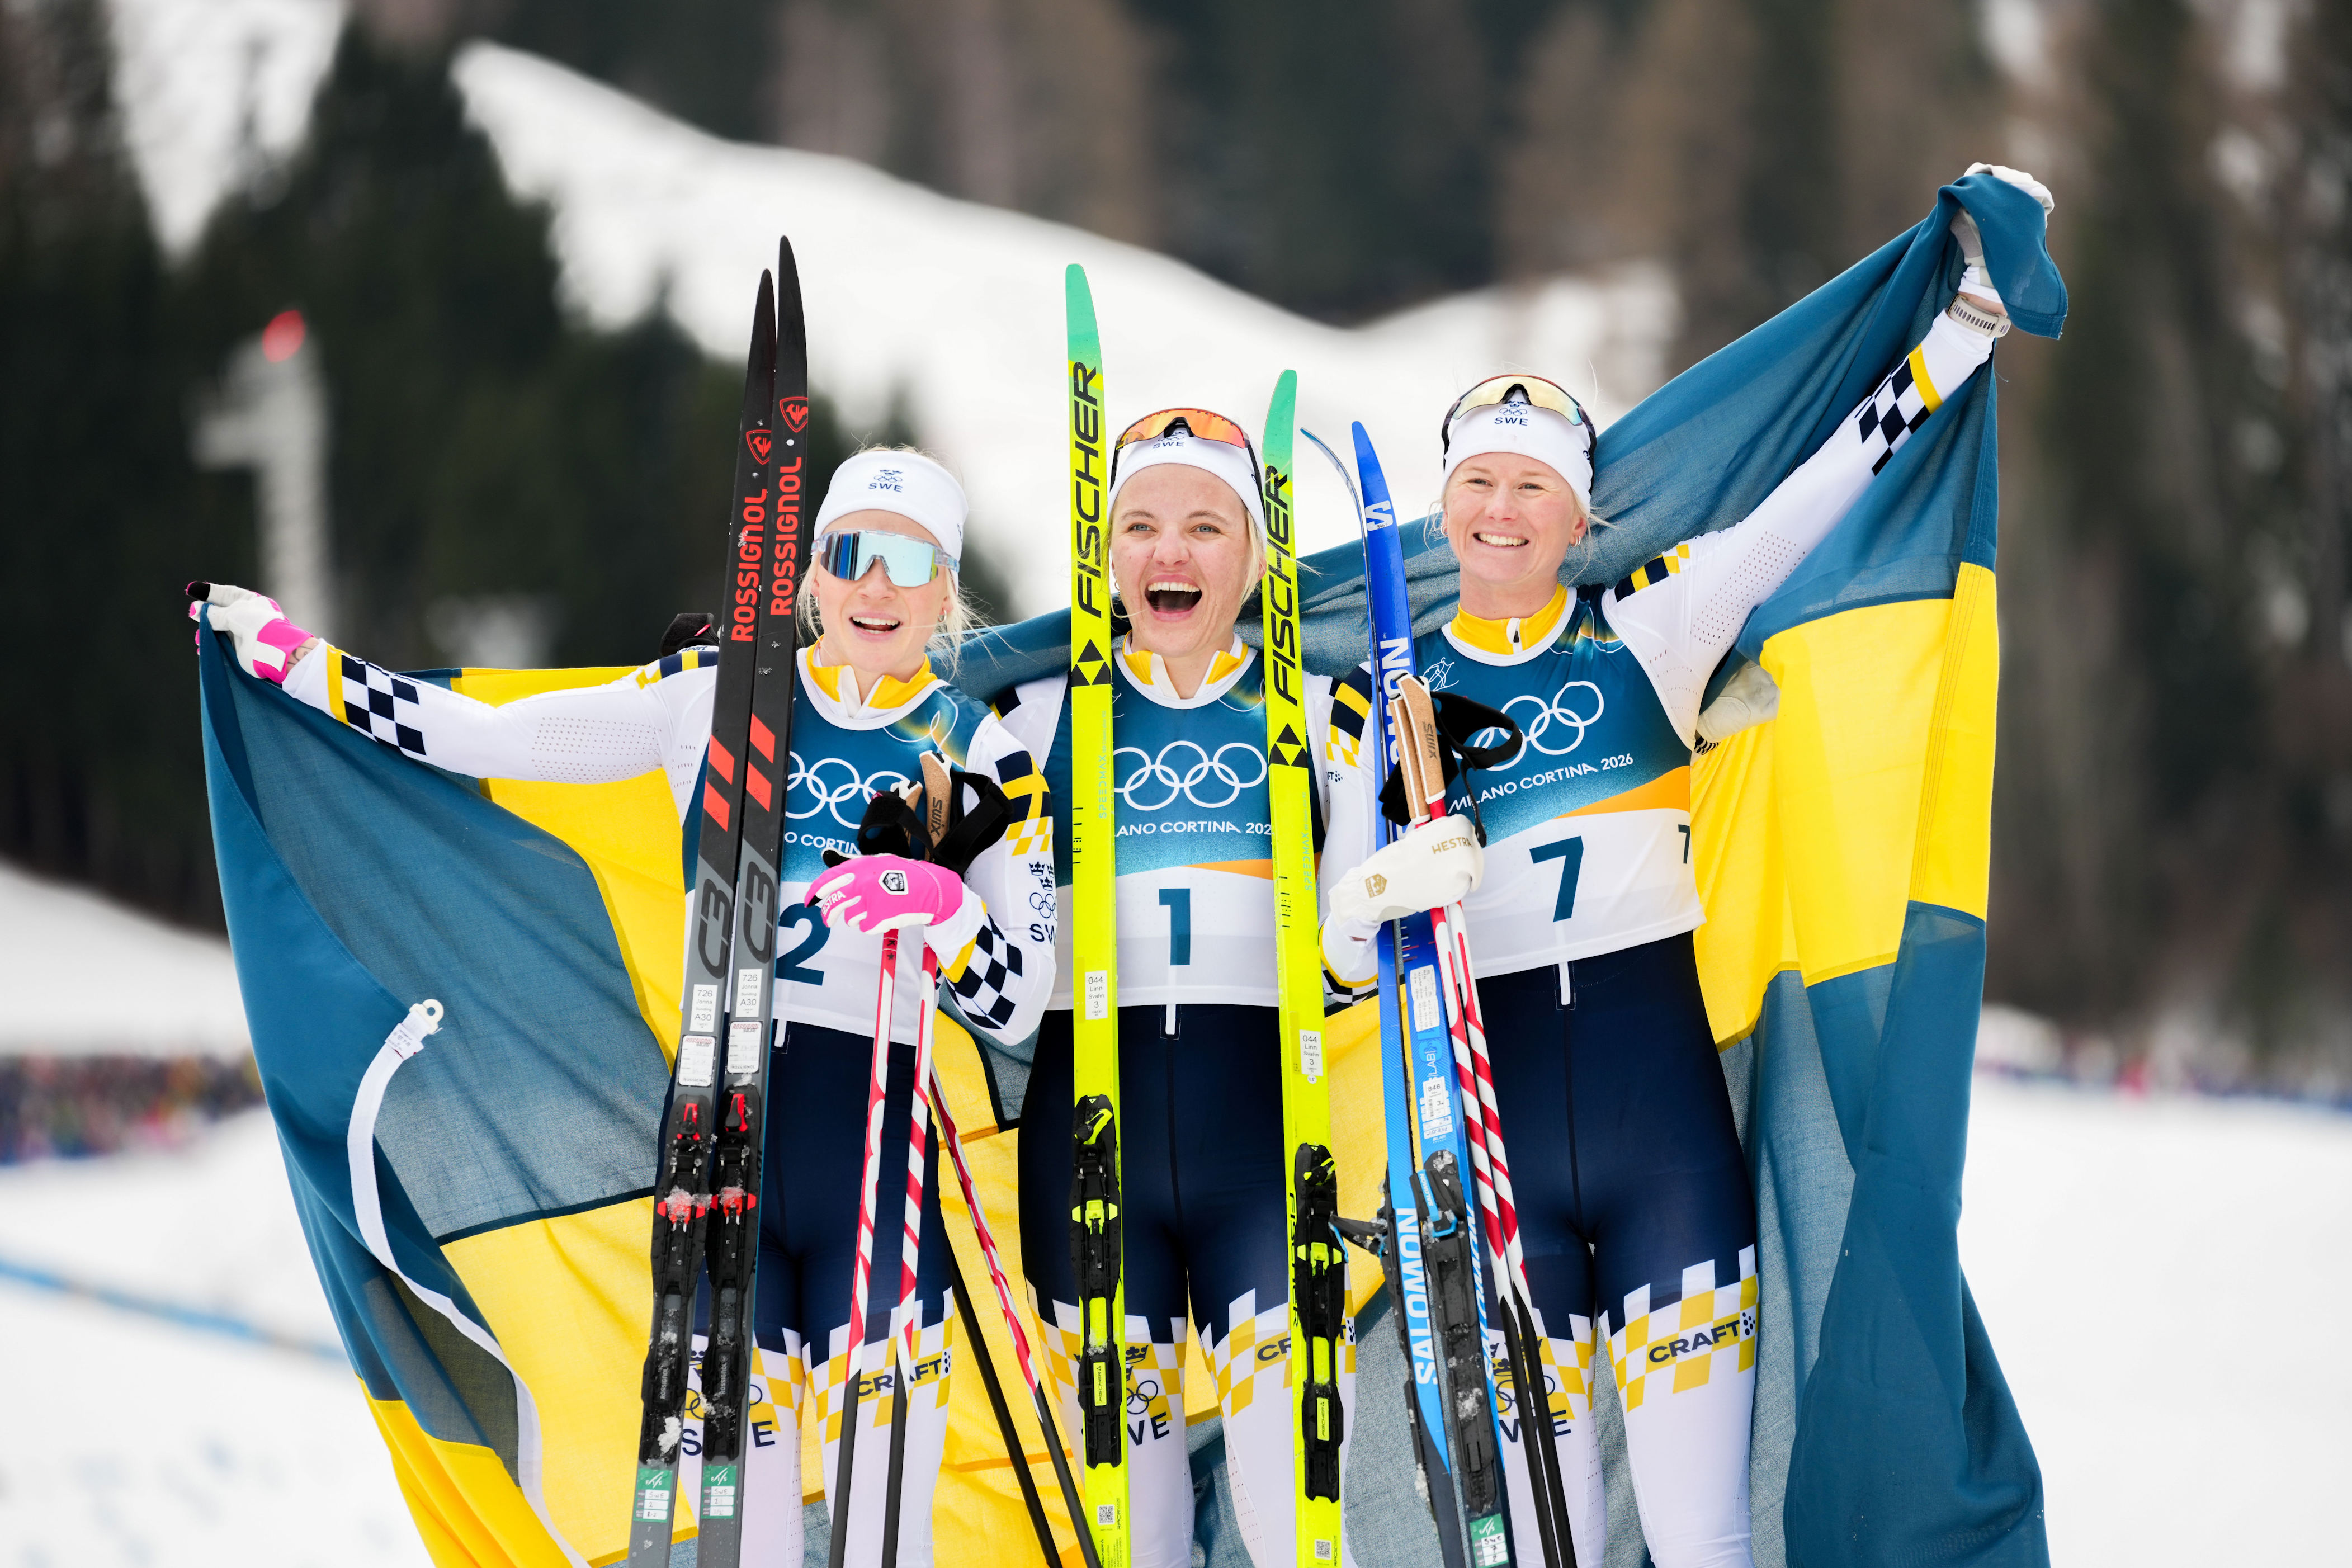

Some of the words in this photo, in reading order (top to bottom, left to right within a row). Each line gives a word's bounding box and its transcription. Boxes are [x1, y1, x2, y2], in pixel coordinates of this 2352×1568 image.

[1494, 417, 1528, 426] SWE
[868, 483, 903, 493] SWE
[1073, 362, 1102, 619] FISCHER
[770, 457, 801, 615] ROSSIGNOL
[731, 488, 767, 641] ROSSIGNOL
[1265, 465, 1298, 706] FISCHER
[1099, 755, 1107, 819] SPEEDMAX
[1520, 763, 1599, 790] CORTINA
[1600, 753, 1633, 771] 2026
[801, 834, 861, 855] CORTIN
[1116, 820, 1156, 837] ANO
[1160, 821, 1241, 834] CORTINA
[1245, 822, 1274, 836] 202
[1432, 837, 1473, 855] HESTRA
[1678, 825, 1690, 864] 7
[1302, 832, 1312, 891] SPEEDMAX
[1529, 835, 1584, 922] 7
[776, 903, 830, 986] 2
[1029, 923, 1056, 946] SW
[1159, 889, 1191, 965] 1
[1420, 1173, 1434, 1207] SALOMON
[1396, 1208, 1439, 1385] SALOMON
[1649, 1320, 1740, 1363] CRAFT
[858, 1358, 942, 1397] CRFT
[682, 1420, 776, 1456] SE
